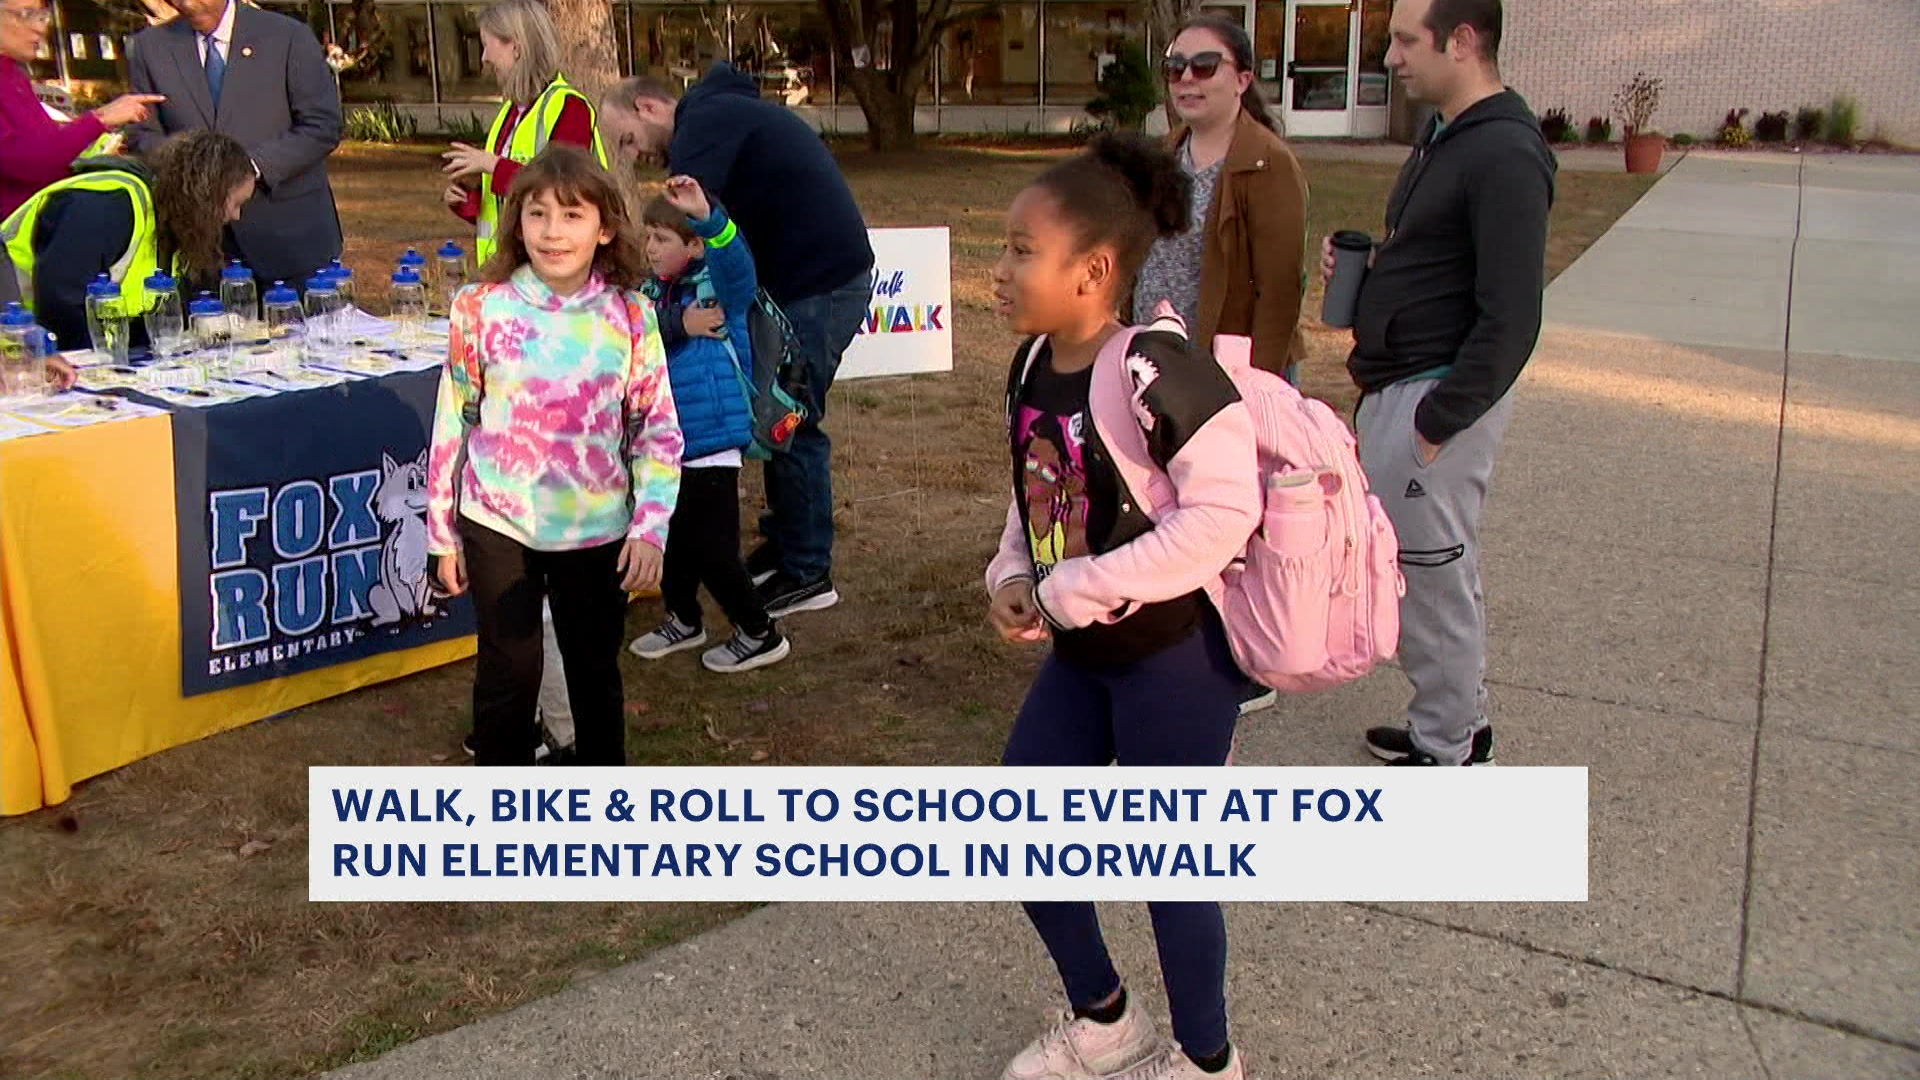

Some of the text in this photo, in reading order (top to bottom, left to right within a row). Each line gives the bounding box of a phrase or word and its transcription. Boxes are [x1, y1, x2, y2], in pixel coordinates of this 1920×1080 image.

[857, 304, 944, 335] WALK
[210, 469, 381, 570] FOX
[210, 544, 383, 651] RUN
[208, 627, 357, 676] ELEMENTARY
